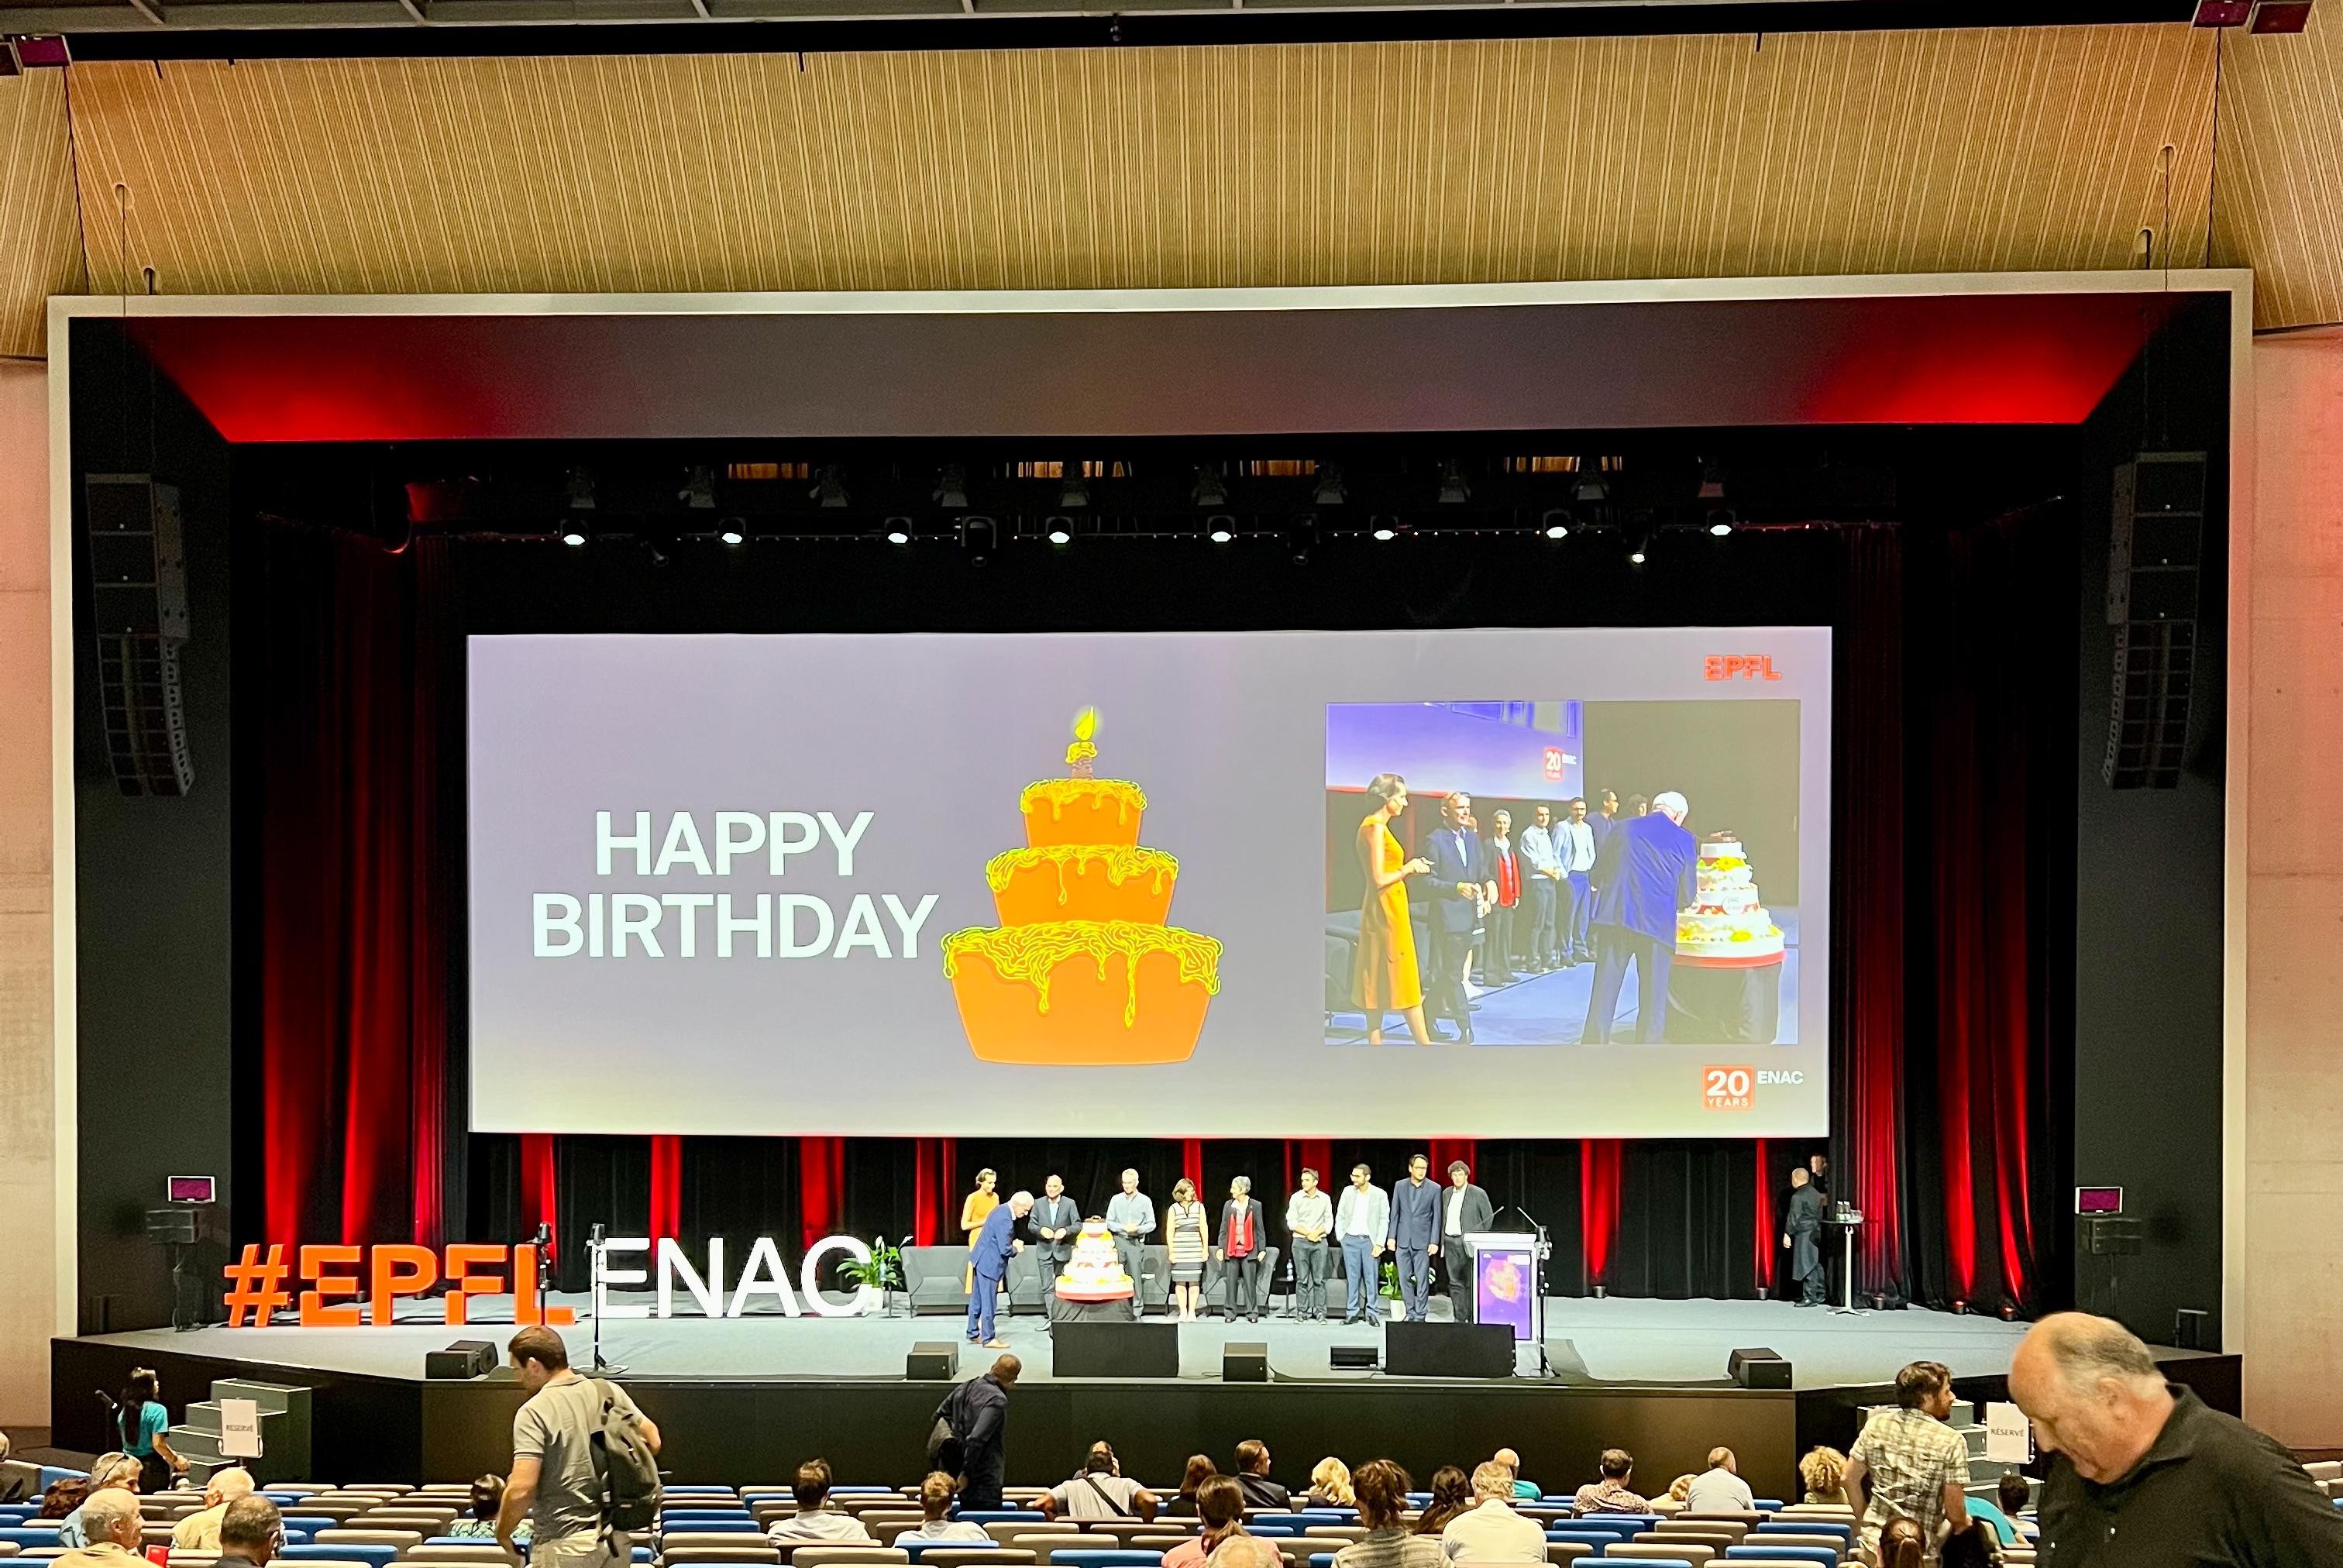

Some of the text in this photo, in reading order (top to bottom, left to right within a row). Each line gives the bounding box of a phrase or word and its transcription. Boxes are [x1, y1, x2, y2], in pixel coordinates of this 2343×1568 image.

[1705, 655, 1781, 681] EPFL
[1547, 751, 1560, 771] 20
[596, 810, 875, 876] HAPPY
[532, 892, 939, 958] BIRTHDAY
[1706, 1070, 1750, 1096] 20
[1756, 1070, 1804, 1085] ENAC
[1707, 1097, 1749, 1107] YEARS
[224, 1235, 874, 1327] #EPFL ENAC
